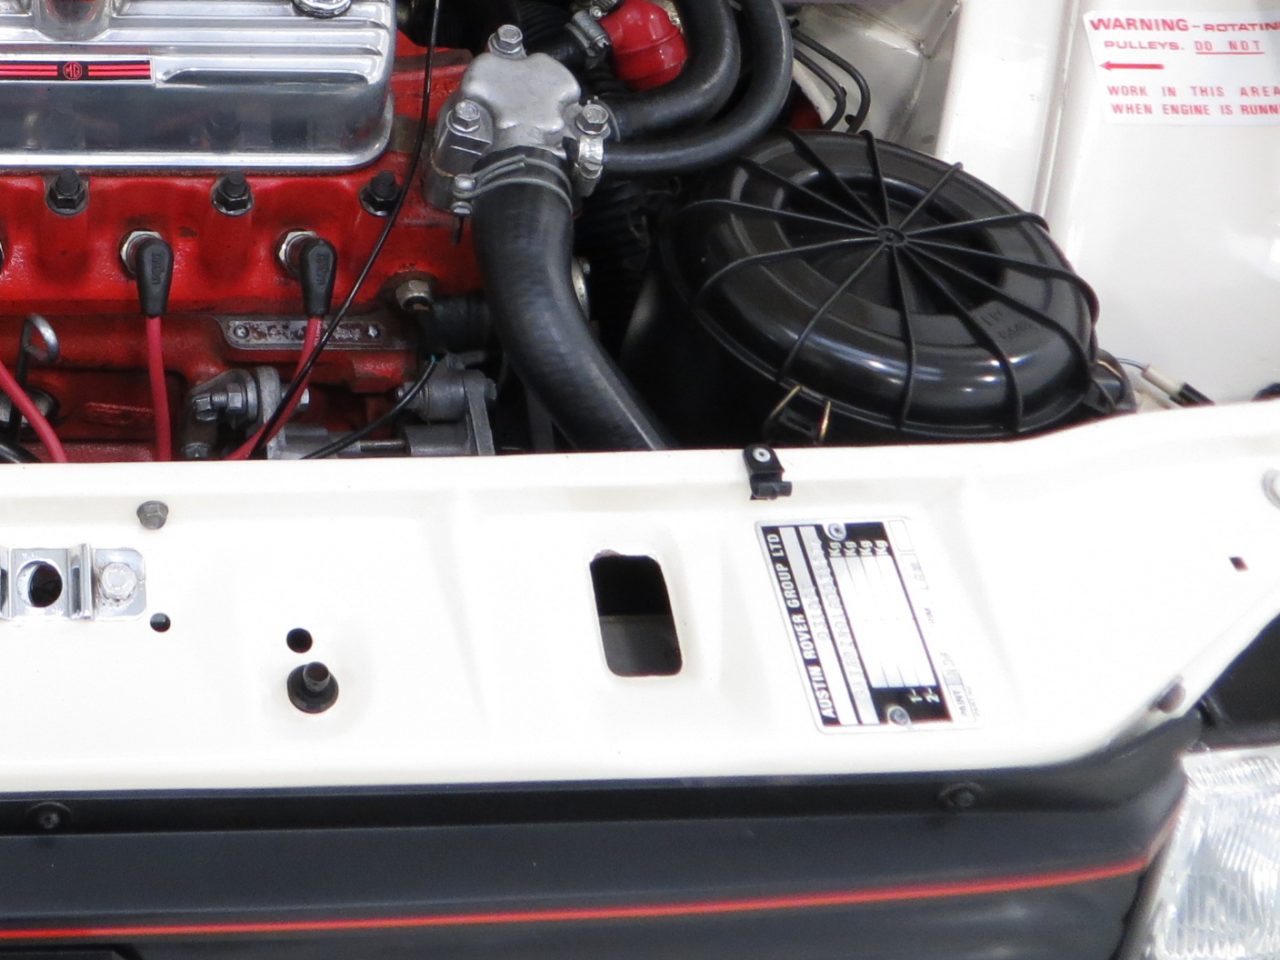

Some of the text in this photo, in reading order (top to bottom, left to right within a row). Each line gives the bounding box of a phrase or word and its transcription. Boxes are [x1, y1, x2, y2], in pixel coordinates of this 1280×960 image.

[1089, 18, 1189, 32] WARNING
[1203, 22, 1280, 32] ROTATIN
[1104, 40, 1262, 51] PULLEYS. DO NOT
[63, 63, 81, 79] MG
[1107, 86, 1280, 97] WORK IN THIS AREA
[1111, 103, 1280, 115] WHEN ENGINE IS RUNN
[767, 533, 784, 557] LTD
[829, 540, 842, 557] Kg
[843, 539, 858, 557] Kg
[858, 539, 874, 556] Kg
[873, 539, 889, 556] Kg
[776, 563, 801, 608] GROUP
[793, 614, 816, 660] ROVER
[811, 665, 835, 718] AUSTIN
